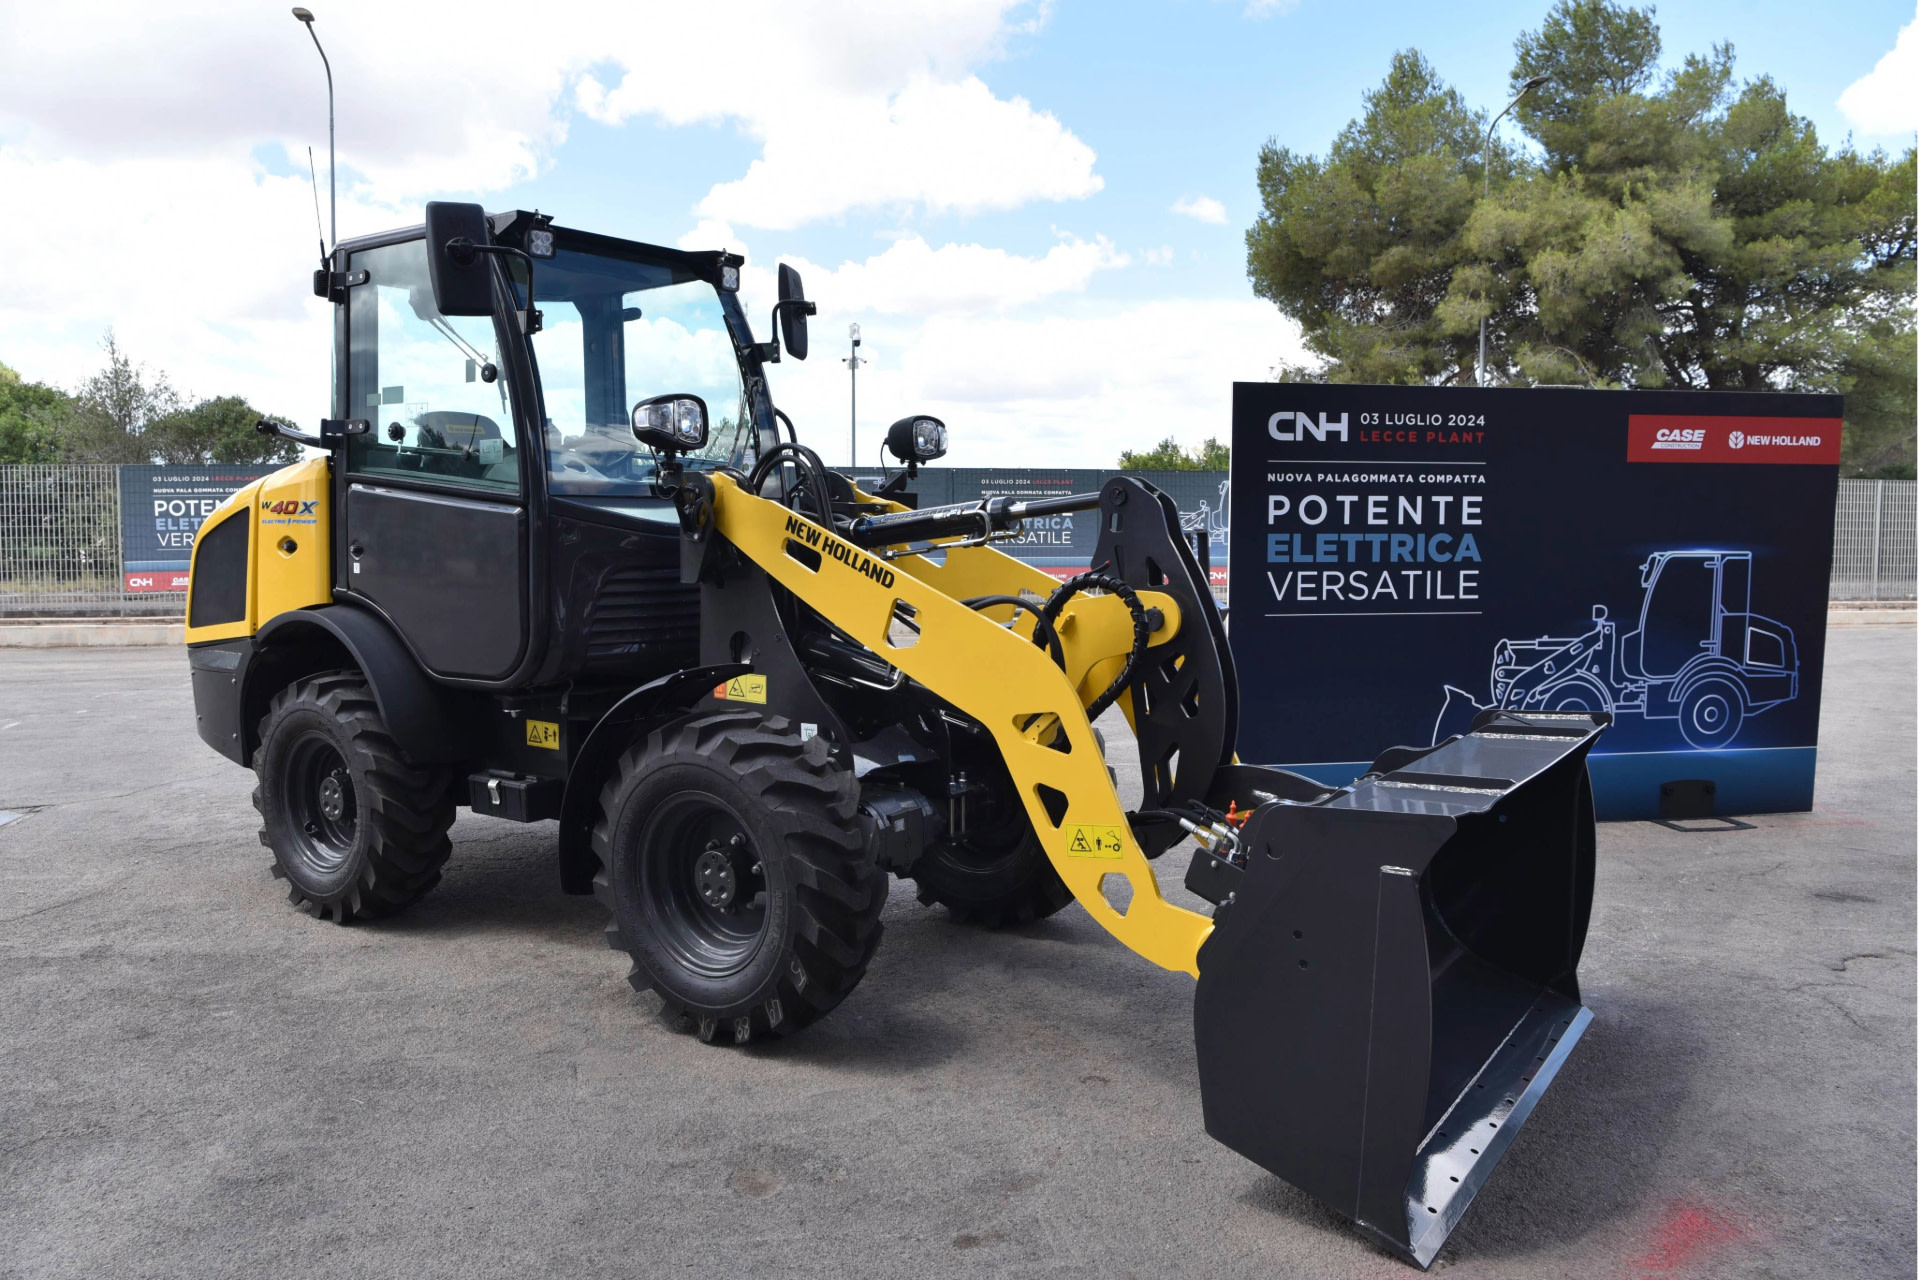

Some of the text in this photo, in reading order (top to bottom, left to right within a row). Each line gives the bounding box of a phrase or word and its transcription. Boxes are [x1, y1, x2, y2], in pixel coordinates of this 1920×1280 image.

[1268, 411, 1349, 442] CNH
[1360, 413, 1486, 427] 03 LUGLIO 2024
[1360, 430, 1485, 443] LECCE PLANT
[1656, 428, 1706, 442] CASE
[1747, 435, 1821, 447] NEW HOLLAND
[1267, 473, 1486, 484] NUOVA PALAGOMMATA COMPATTA
[154, 500, 222, 516] POTE
[1268, 494, 1483, 525] POTENTE
[785, 515, 895, 589] NEW HOLLAND
[1267, 533, 1482, 563] ELETTRICA
[129, 578, 153, 587] CNH
[1267, 570, 1480, 601] VERSATILE
